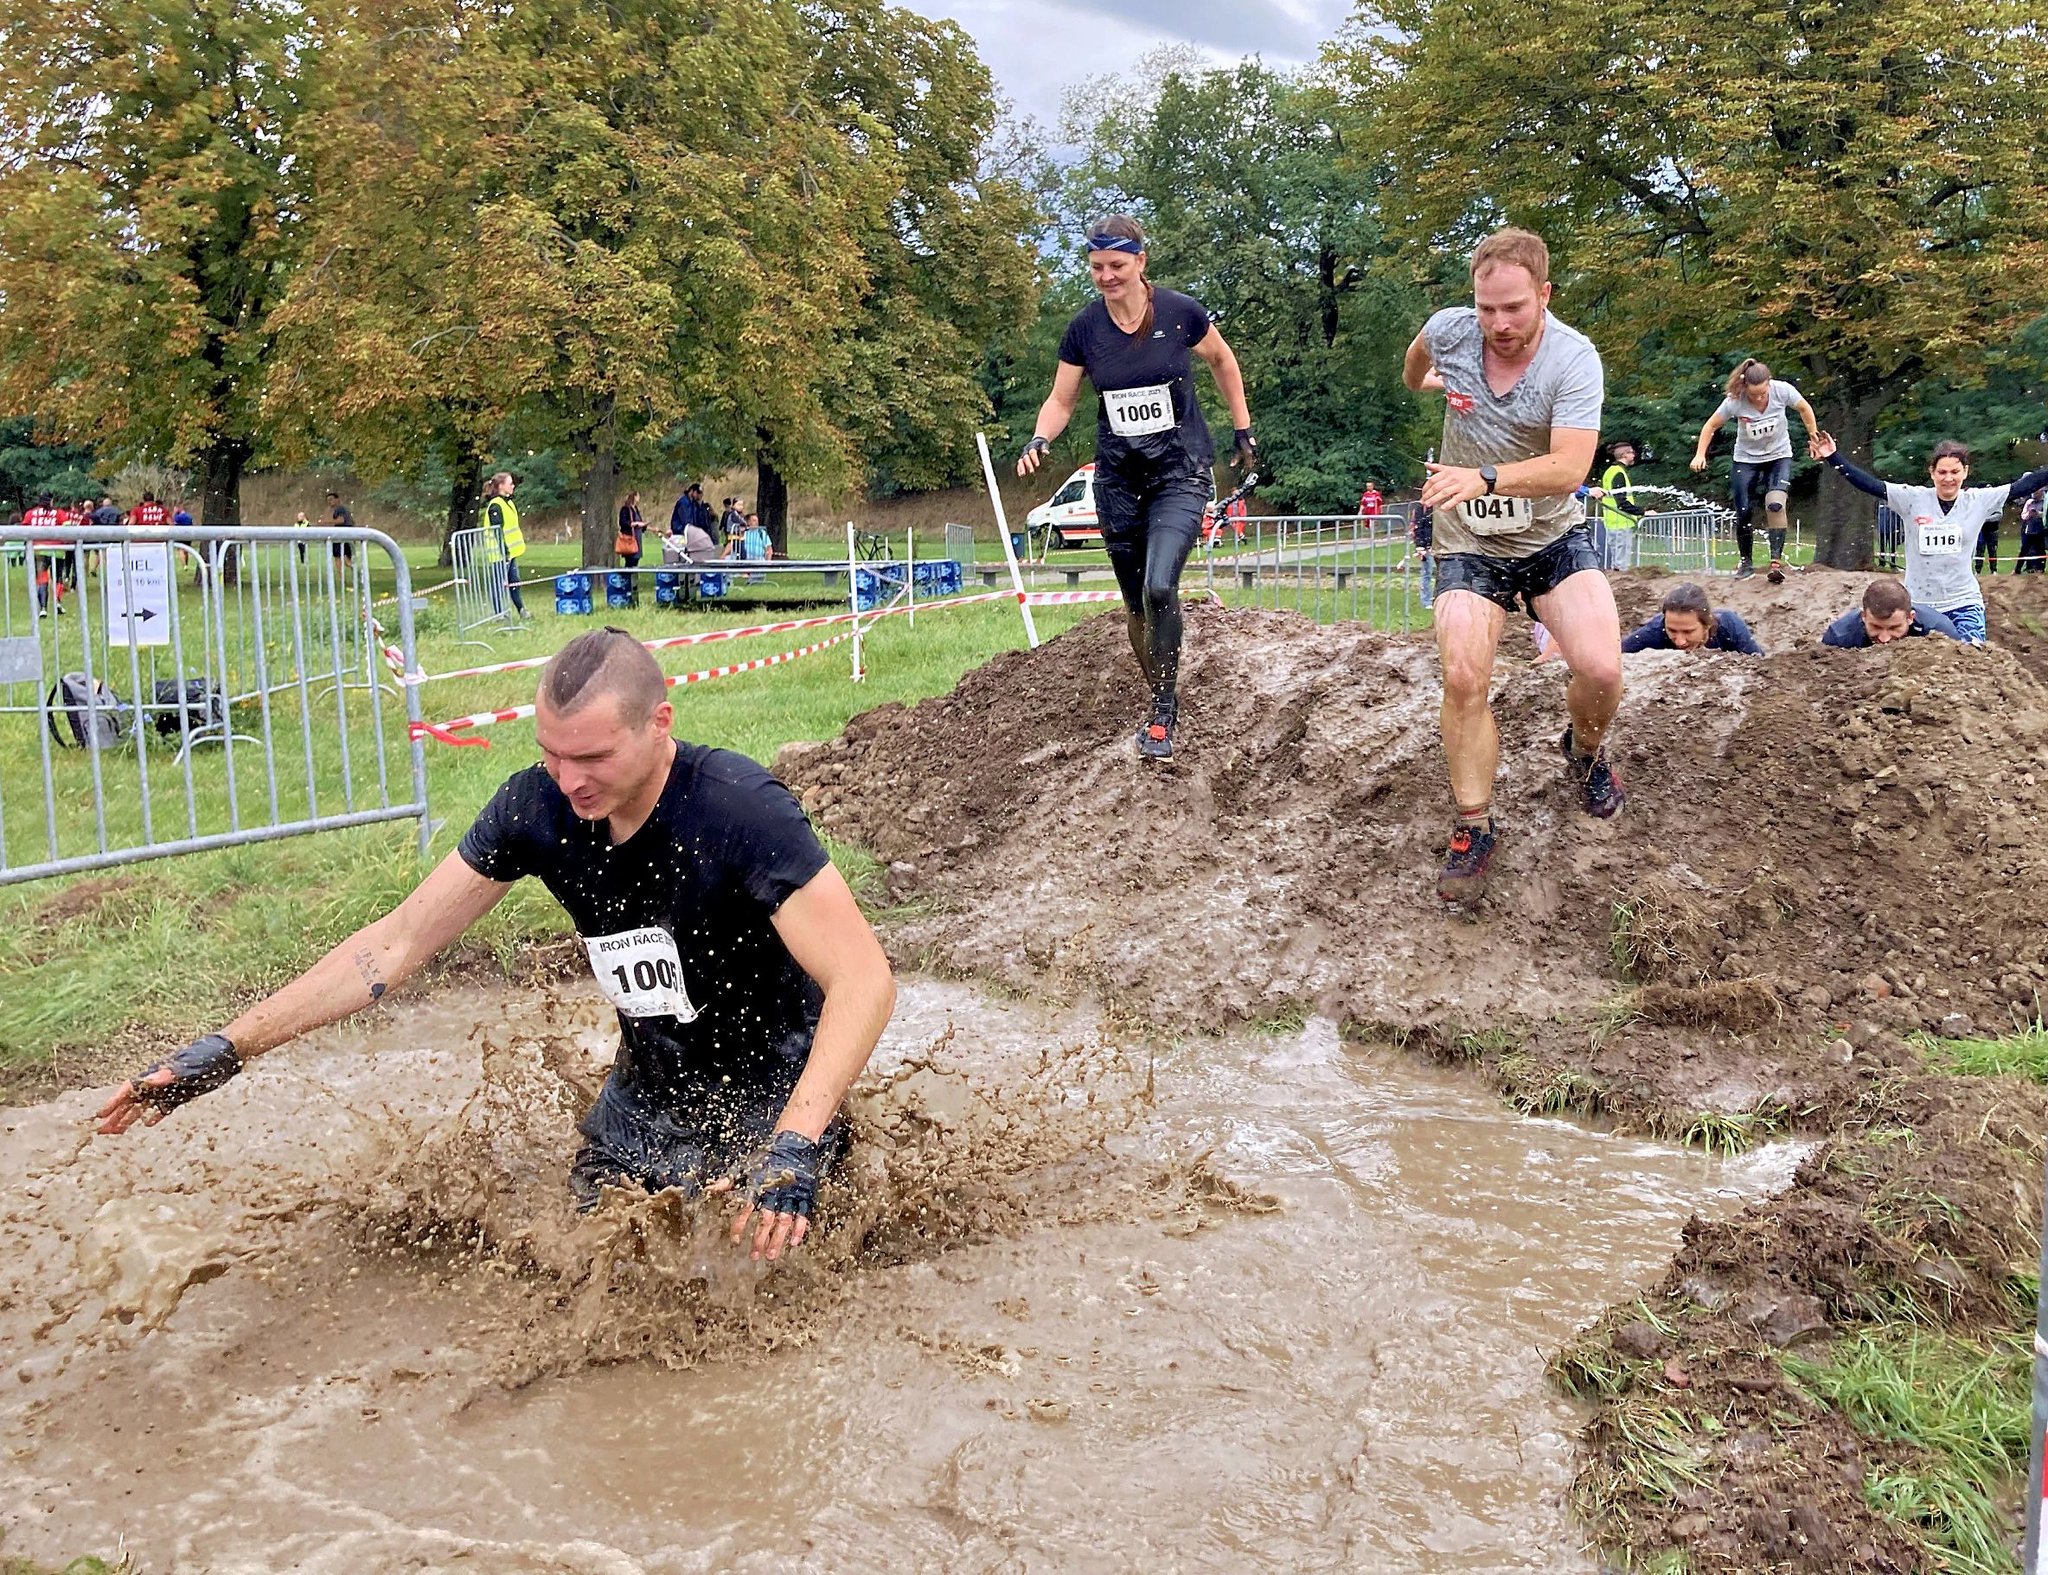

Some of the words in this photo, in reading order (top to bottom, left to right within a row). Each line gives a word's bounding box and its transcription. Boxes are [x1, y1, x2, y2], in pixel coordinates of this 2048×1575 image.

[1116, 402, 1162, 422] 1006
[1752, 425, 1775, 436] 1117
[1464, 497, 1514, 519] 1041
[1925, 534, 1956, 546] 1116
[122, 560, 154, 571] IEL
[599, 937, 631, 953] IRON
[632, 933, 665, 946] RACE
